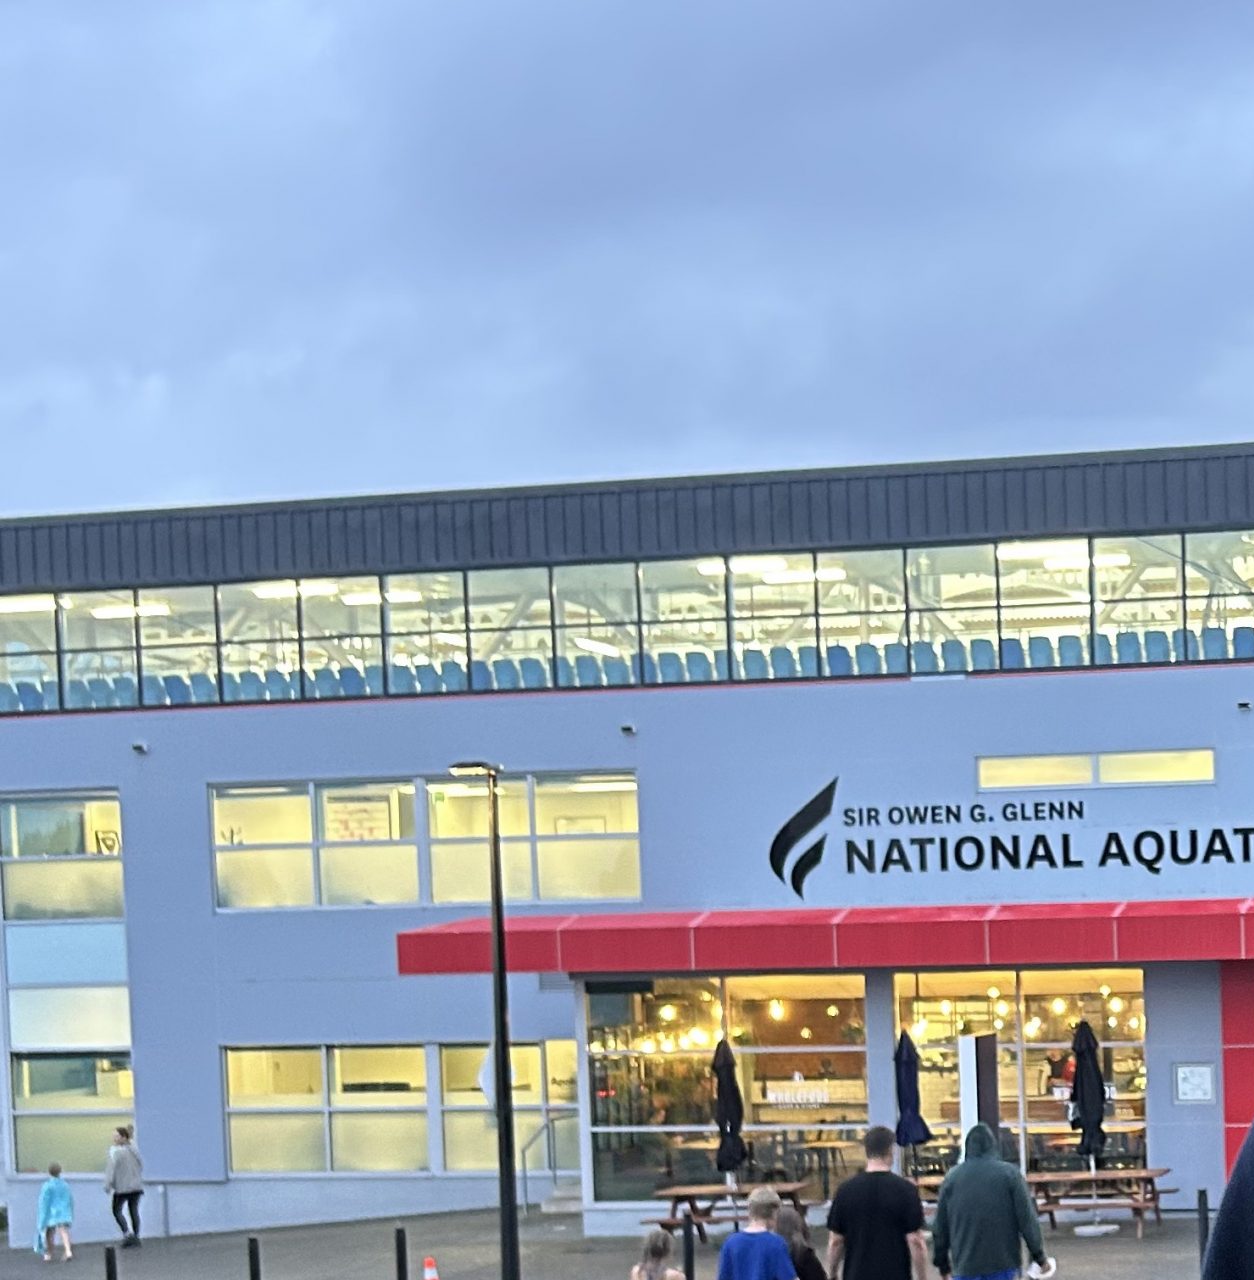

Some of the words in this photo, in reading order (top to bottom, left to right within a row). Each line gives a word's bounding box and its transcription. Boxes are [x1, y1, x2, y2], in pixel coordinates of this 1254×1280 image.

[843, 807, 881, 827] SIR
[888, 804, 962, 825] OWEN
[969, 804, 994, 823] G.
[1002, 800, 1084, 821] GLENN
[845, 833, 1084, 874] NATIONAL
